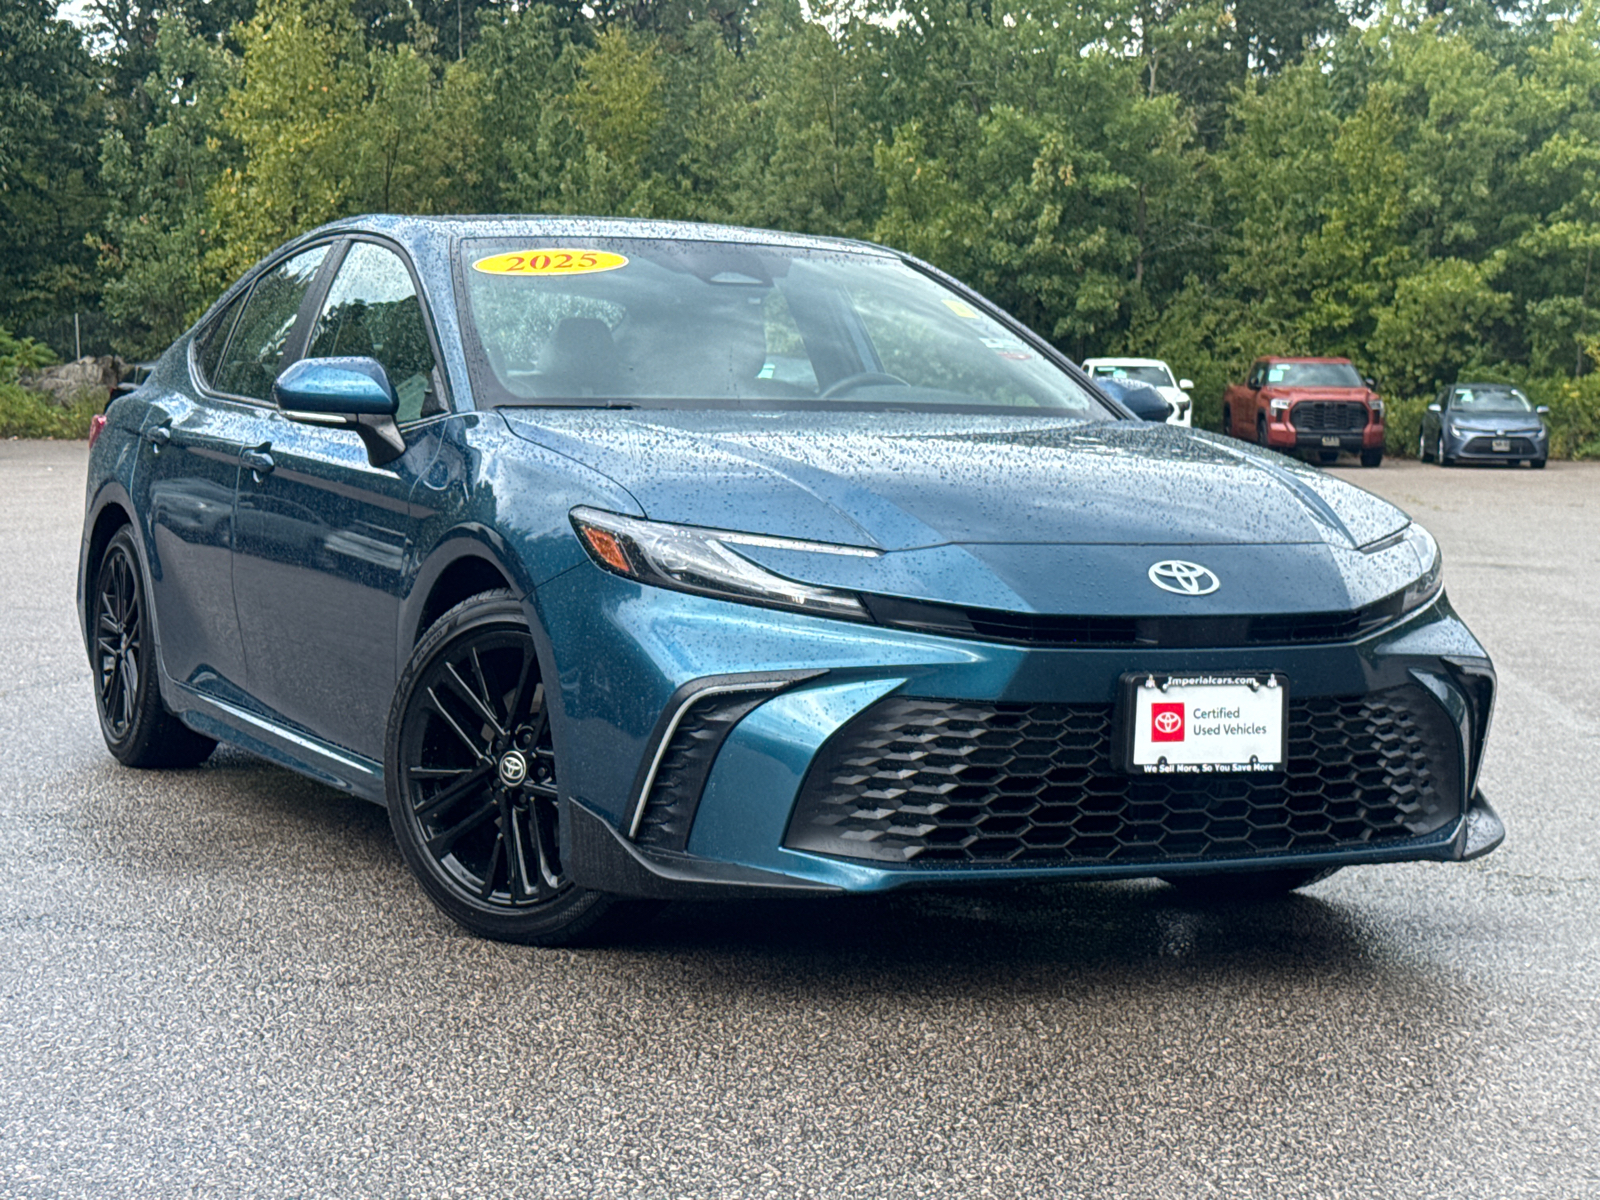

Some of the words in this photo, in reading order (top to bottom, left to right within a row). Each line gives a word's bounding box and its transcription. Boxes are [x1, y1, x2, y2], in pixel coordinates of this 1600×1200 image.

[505, 253, 598, 272] 2025
[1167, 676, 1256, 686] Imperialcars.com
[1193, 707, 1240, 719] Certified
[1193, 724, 1220, 736] Used
[1223, 722, 1267, 735] Vehicles
[1143, 764, 1157, 772] We
[1159, 764, 1175, 773] Sell
[1176, 764, 1200, 773] More,
[1202, 764, 1213, 772] So
[1215, 764, 1230, 772] You
[1232, 763, 1251, 772] Save
[1253, 763, 1274, 772] More
